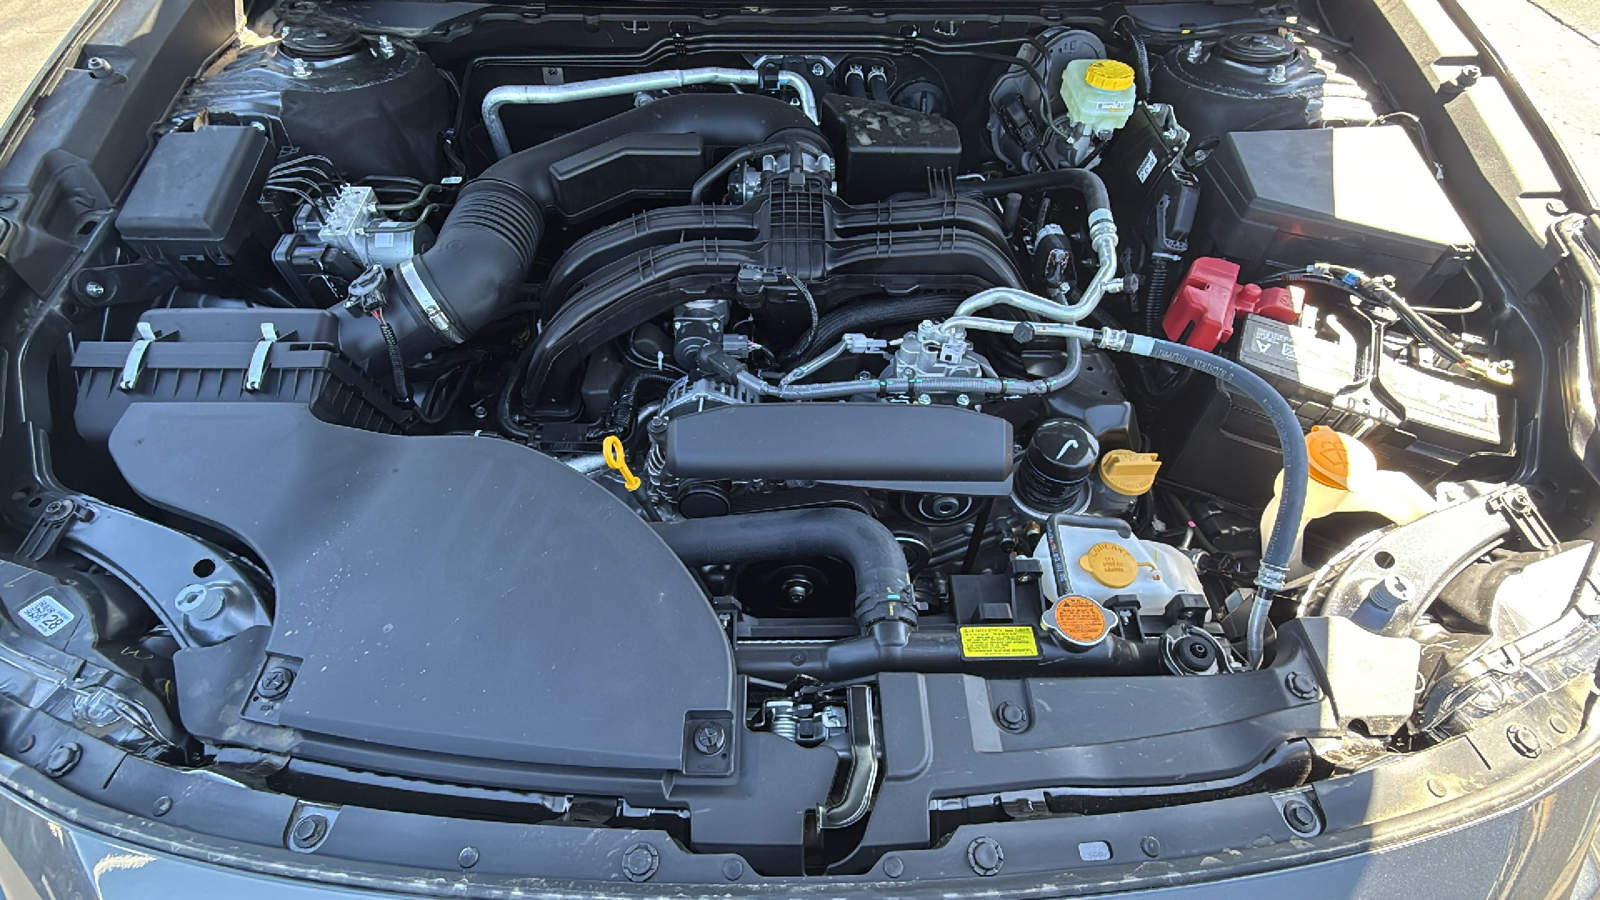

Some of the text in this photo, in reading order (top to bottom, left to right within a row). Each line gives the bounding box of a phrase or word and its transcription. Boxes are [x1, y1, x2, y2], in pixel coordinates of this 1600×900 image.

[1256, 339, 1272, 354] A
[1192, 359, 1227, 377] NICHIRIN
[41, 614, 64, 630] 28
